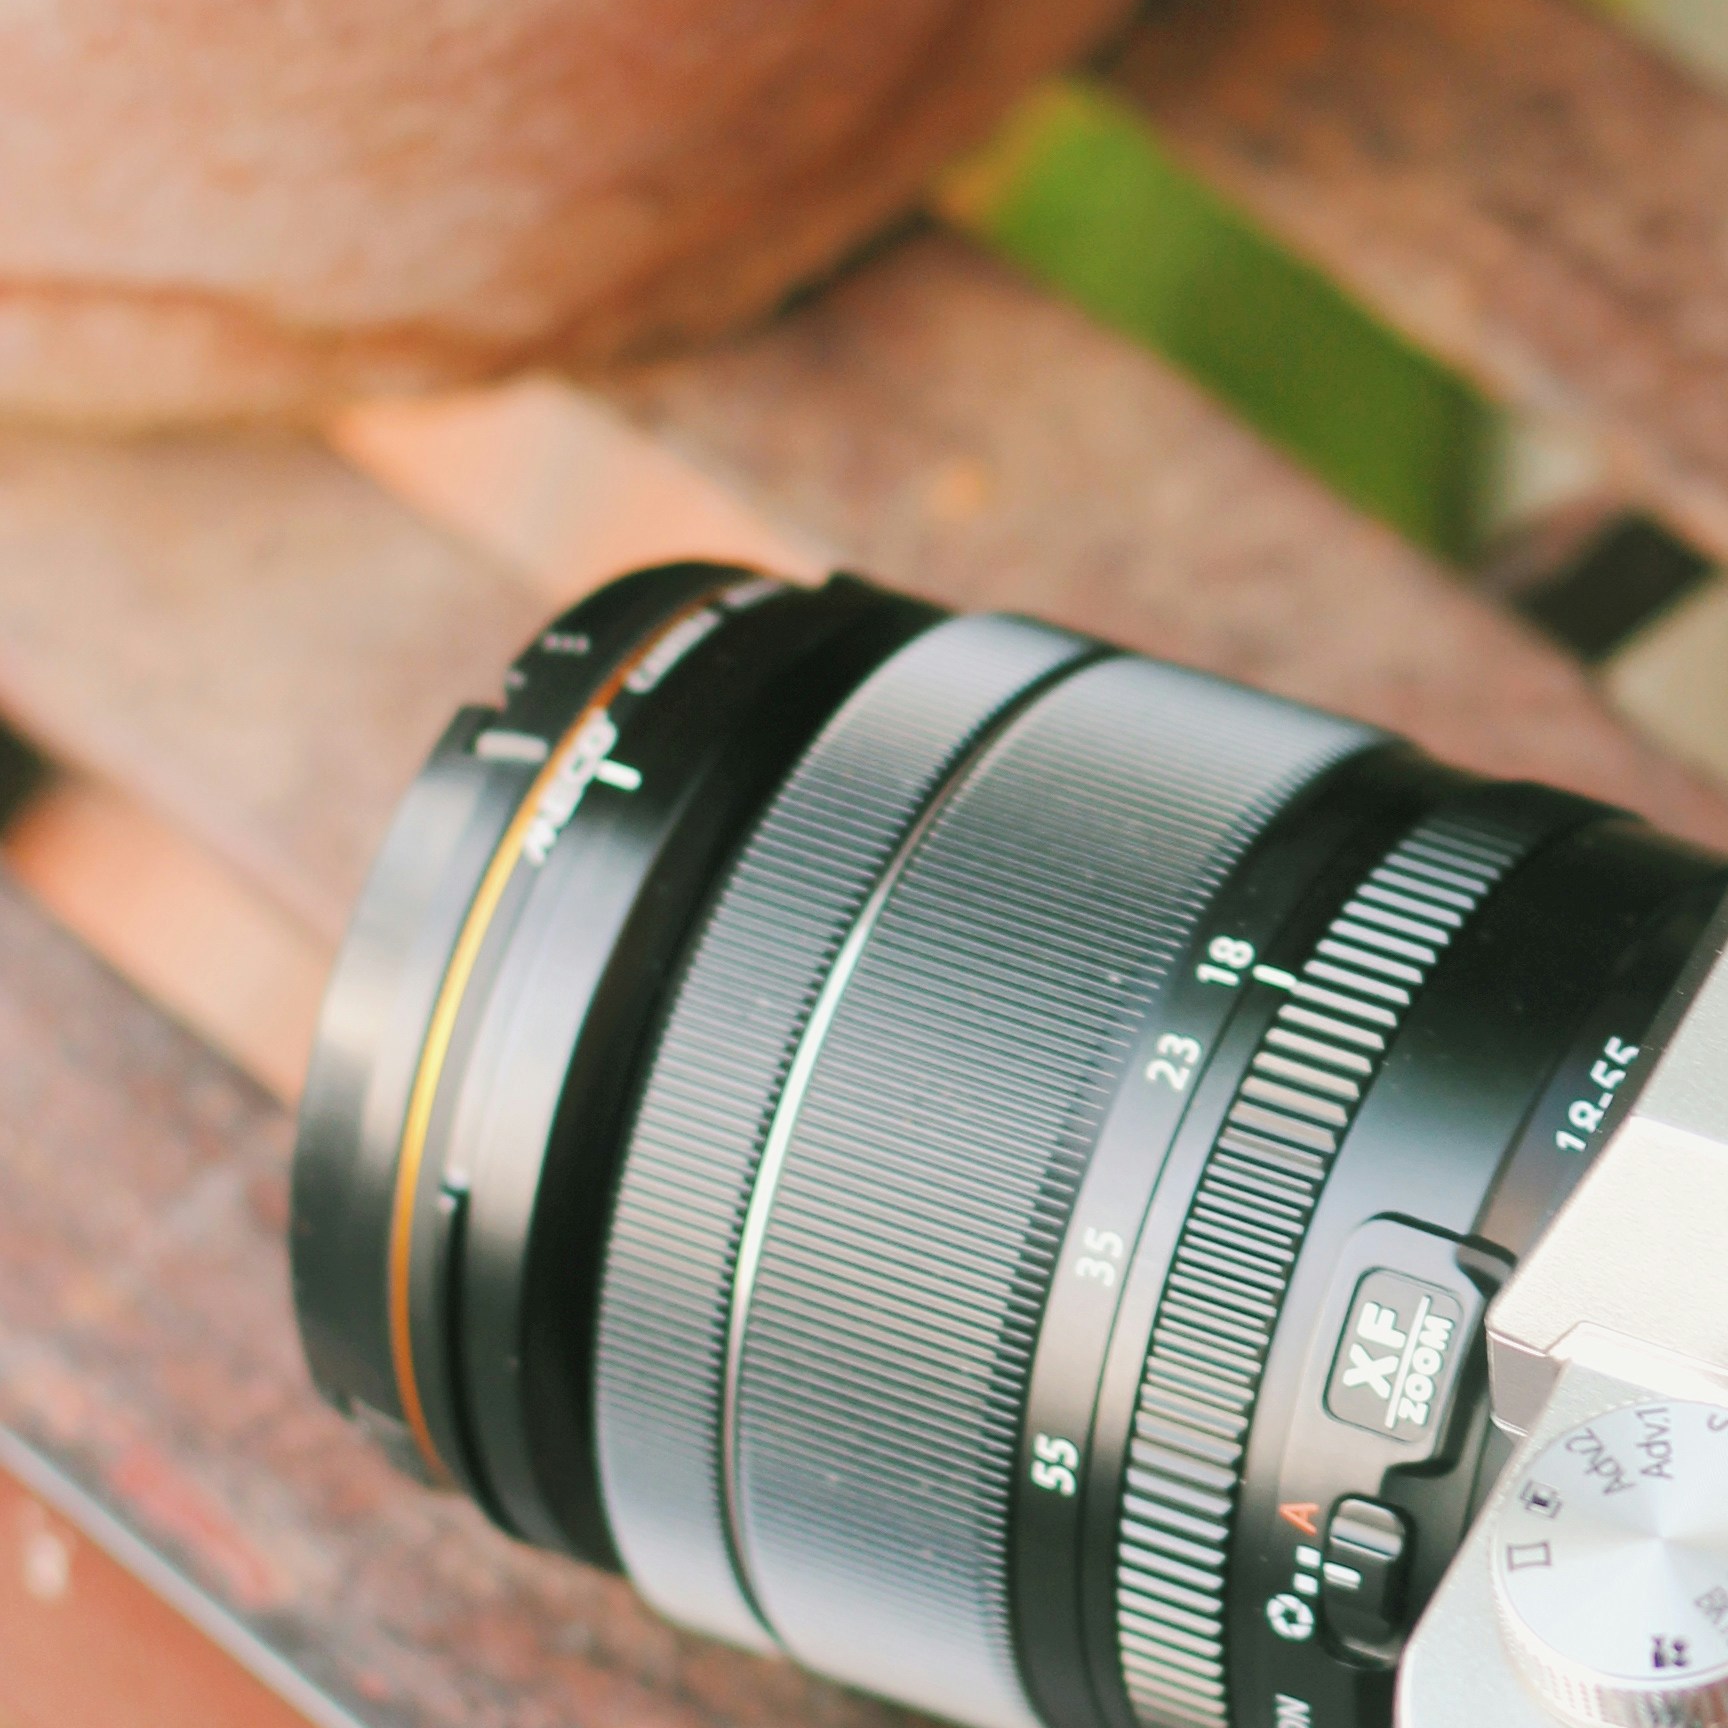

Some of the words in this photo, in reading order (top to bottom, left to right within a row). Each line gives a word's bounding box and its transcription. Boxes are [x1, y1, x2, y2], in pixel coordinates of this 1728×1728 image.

[1197, 935, 1255, 987] 18
[1145, 1031, 1201, 1091] 23
[1076, 1227, 1124, 1287] 35
[1342, 1301, 1407, 1399] XF
[1398, 1314, 1454, 1426] ZOOM
[1030, 1434, 1079, 1497] 55
[1279, 1502, 1320, 1537] A
